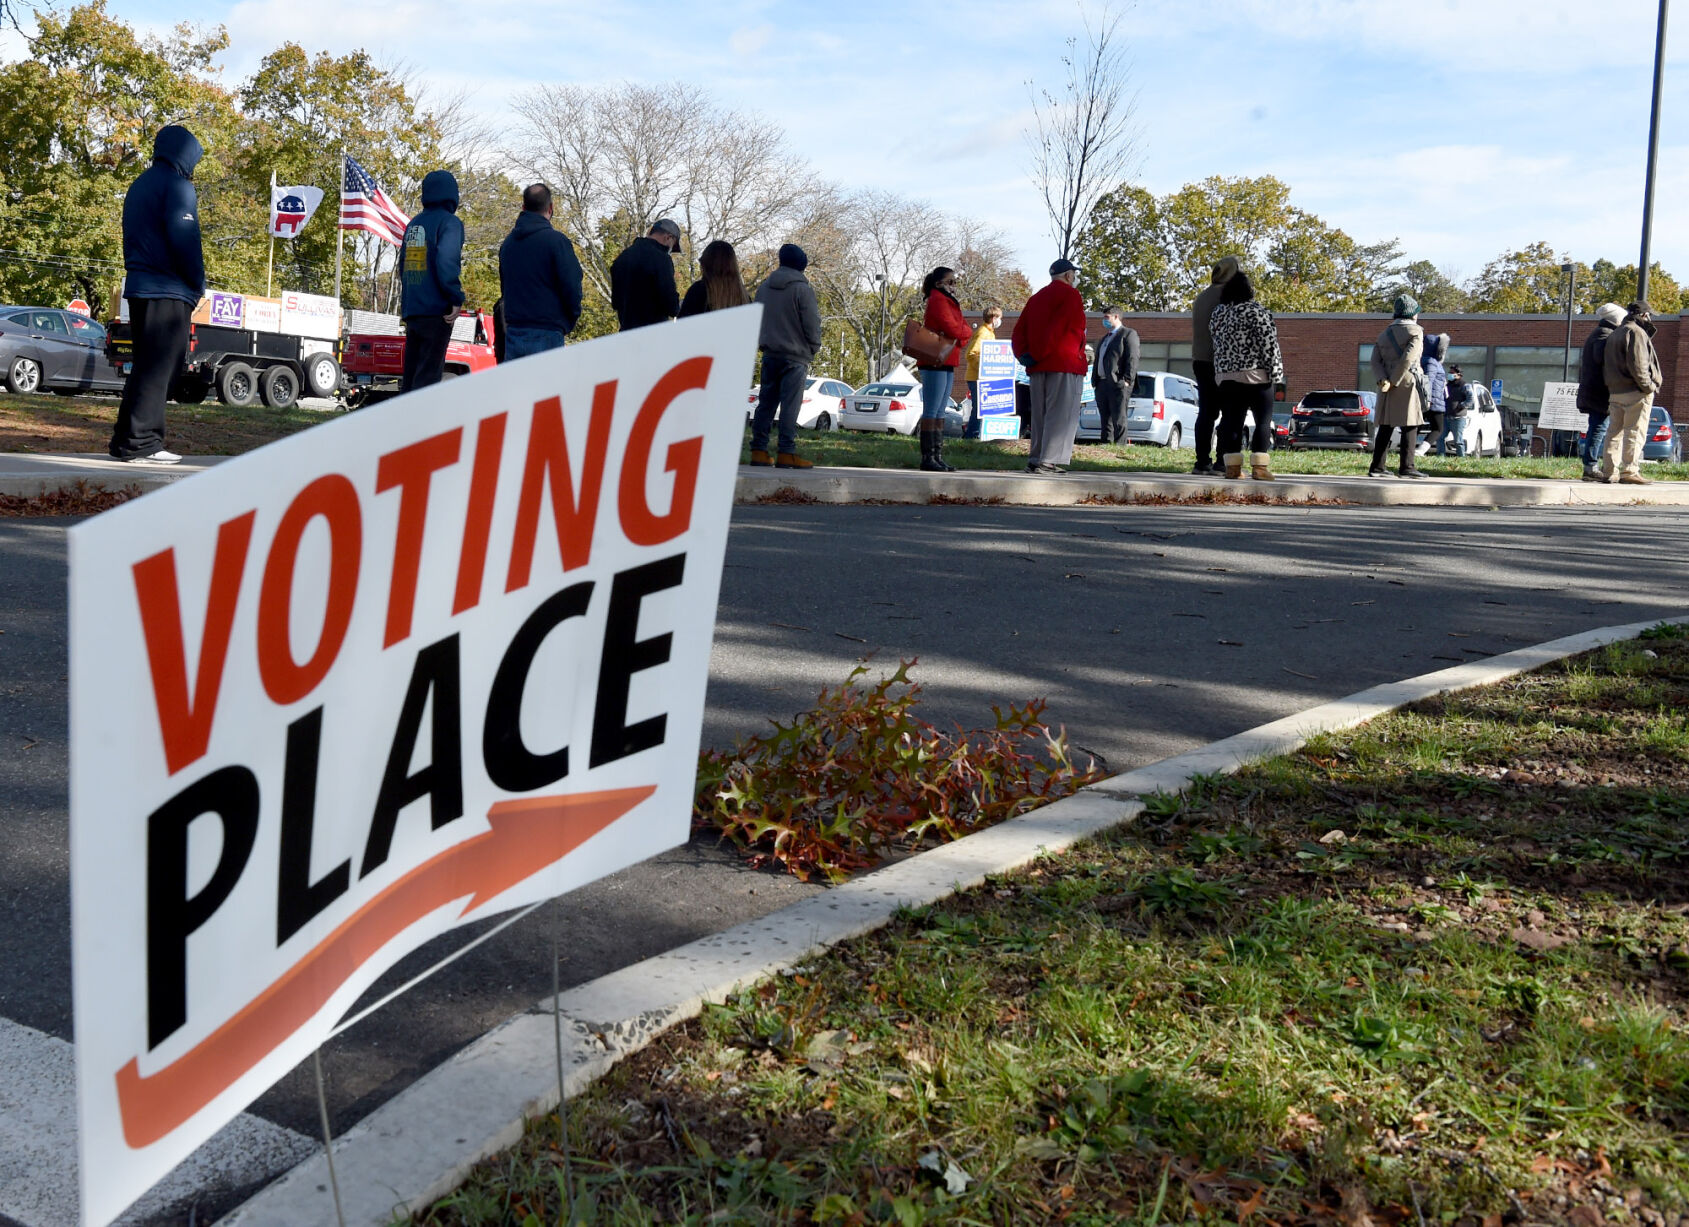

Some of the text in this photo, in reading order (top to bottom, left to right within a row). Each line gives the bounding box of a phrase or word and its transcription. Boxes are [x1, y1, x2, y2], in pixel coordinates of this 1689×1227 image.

[215, 299, 239, 316] FAY
[983, 355, 1014, 363] HARRIS
[131, 355, 714, 776] VOTING
[148, 552, 687, 1052] PLACE
